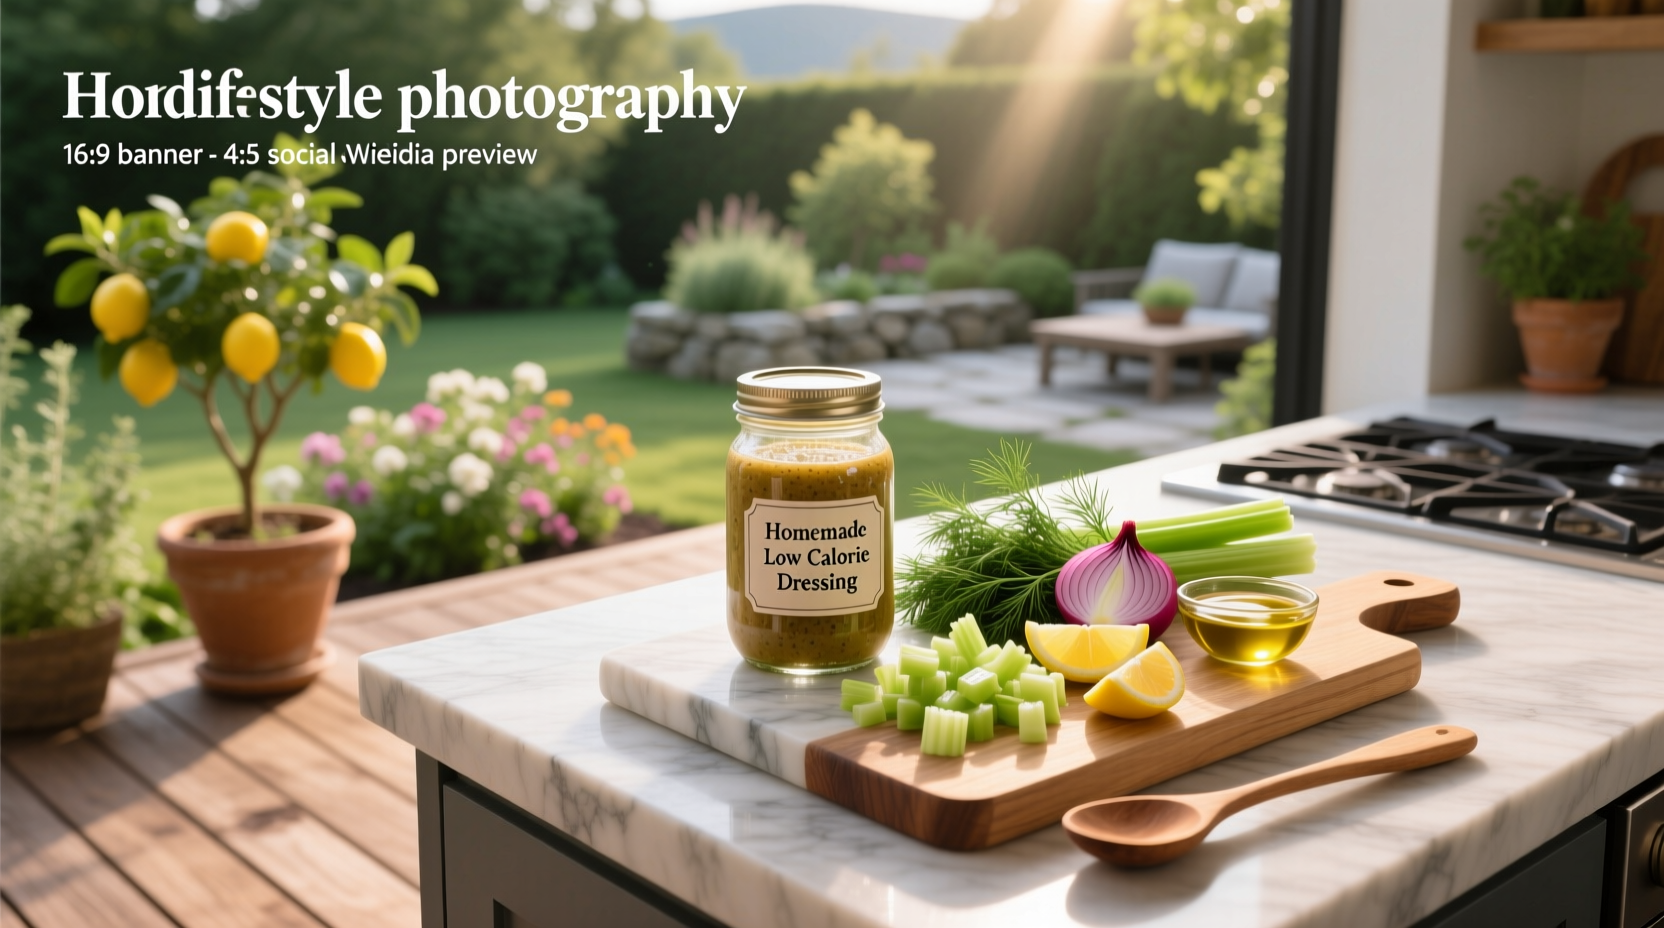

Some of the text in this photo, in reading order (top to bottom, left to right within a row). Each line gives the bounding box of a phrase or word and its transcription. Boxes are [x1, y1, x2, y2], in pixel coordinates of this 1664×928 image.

[765, 519, 867, 541] Homemade
[763, 546, 870, 567] Low Calorie
[777, 572, 858, 595] Dressing
